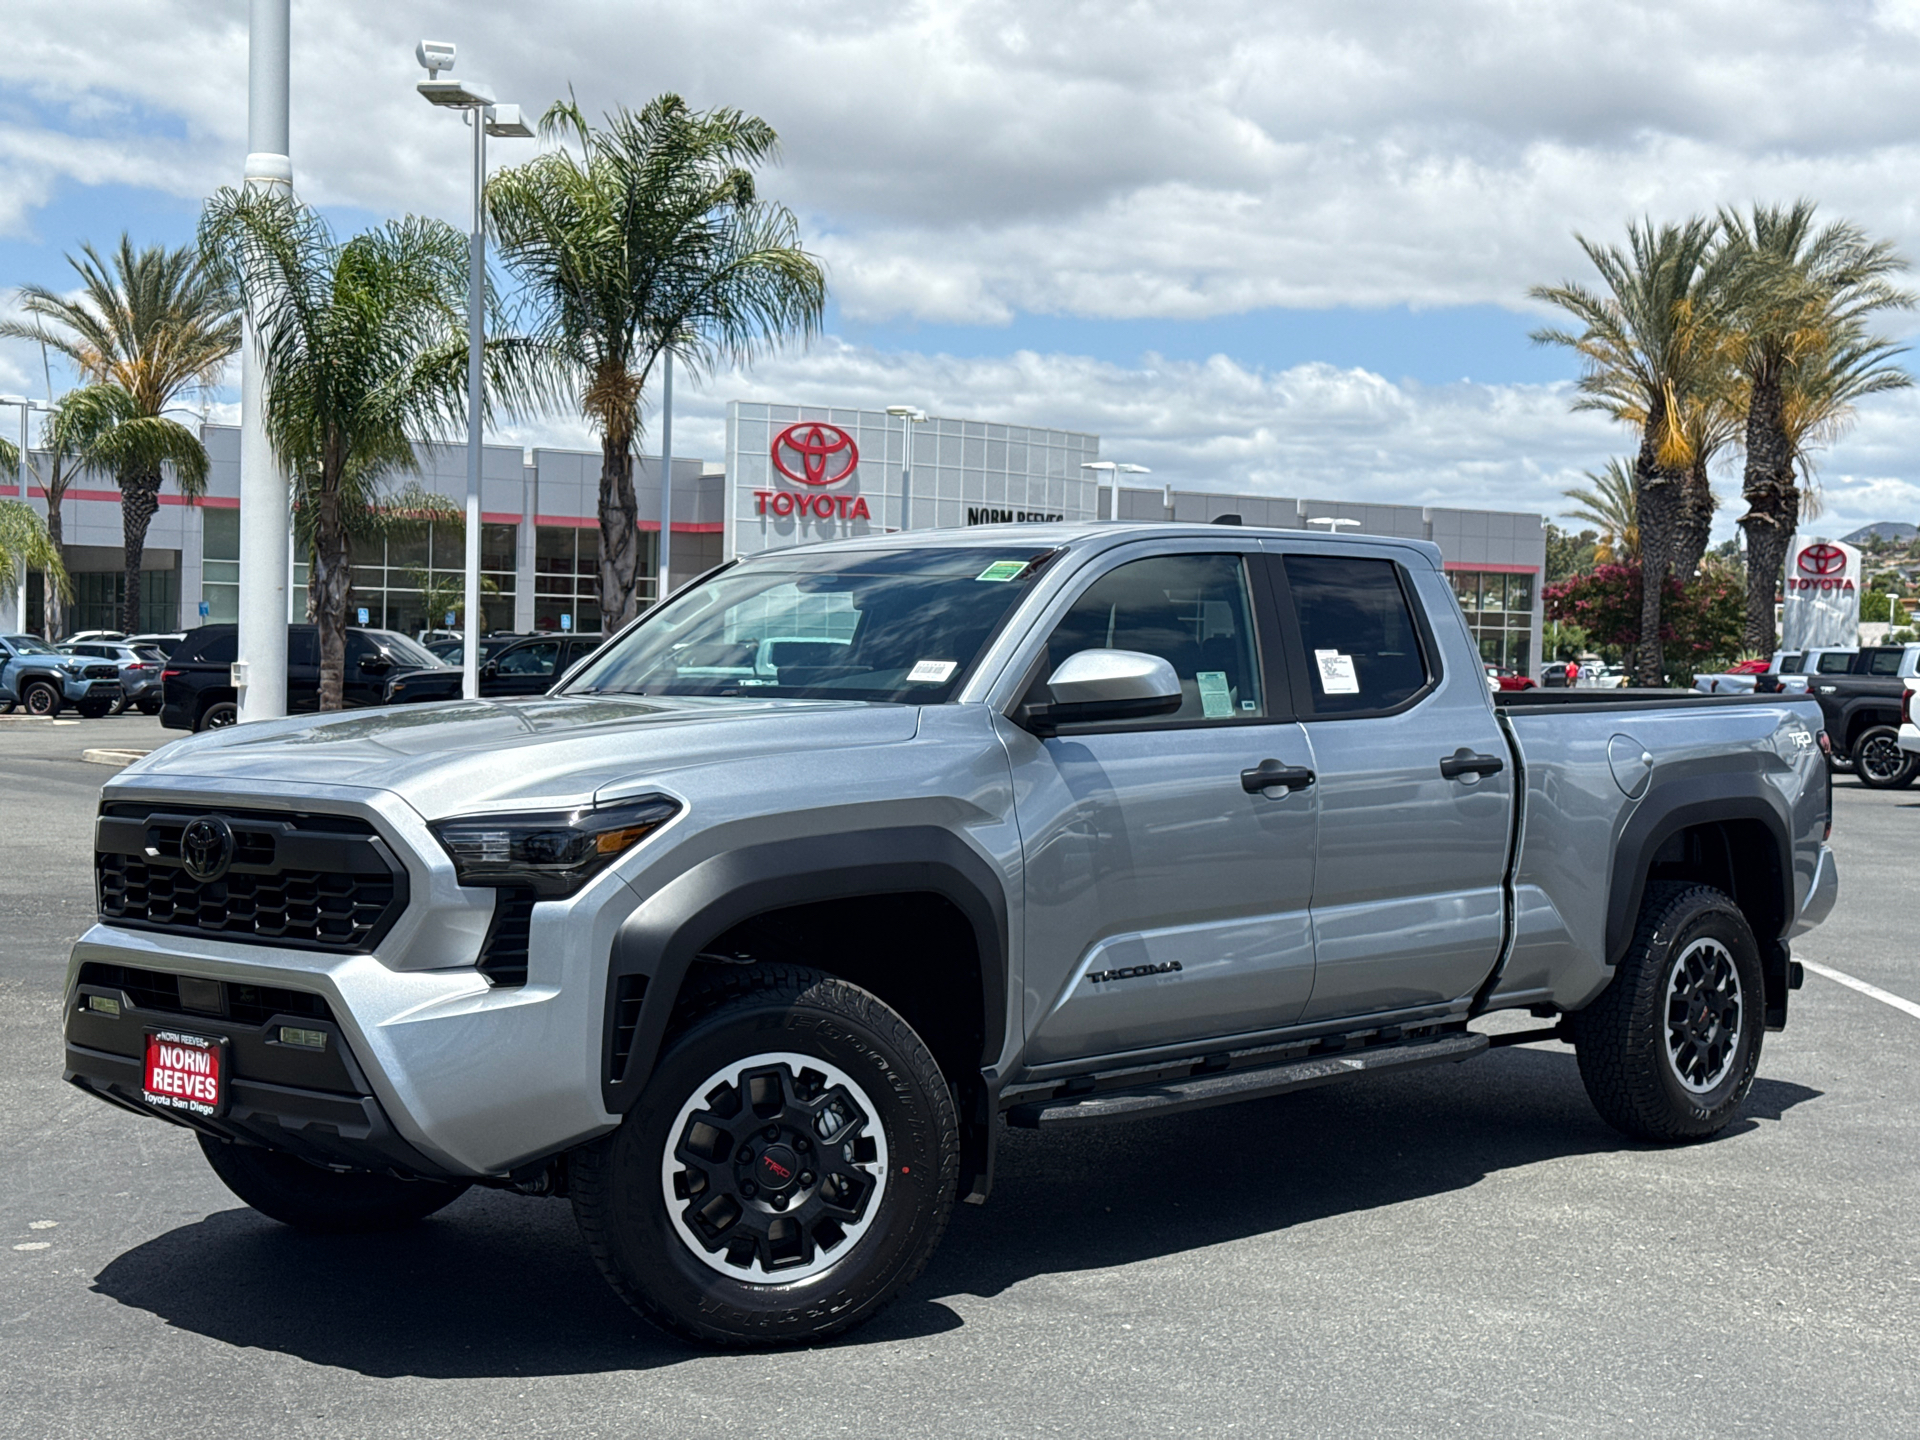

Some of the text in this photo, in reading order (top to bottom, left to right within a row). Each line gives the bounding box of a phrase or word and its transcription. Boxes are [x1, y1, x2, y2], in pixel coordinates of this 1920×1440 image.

[753, 490, 871, 520] TOYOTA
[967, 507, 1013, 526] NORM
[1787, 577, 1855, 591] TOYOTA
[1788, 731, 1812, 749] TRD
[1085, 960, 1183, 984] TACOMA
[161, 1031, 204, 1047] NORM REEVES
[159, 1045, 210, 1075] NORM
[152, 1067, 216, 1100] REEVES
[143, 1091, 214, 1116] Toyota San Diego
[763, 1156, 791, 1179] TRD
